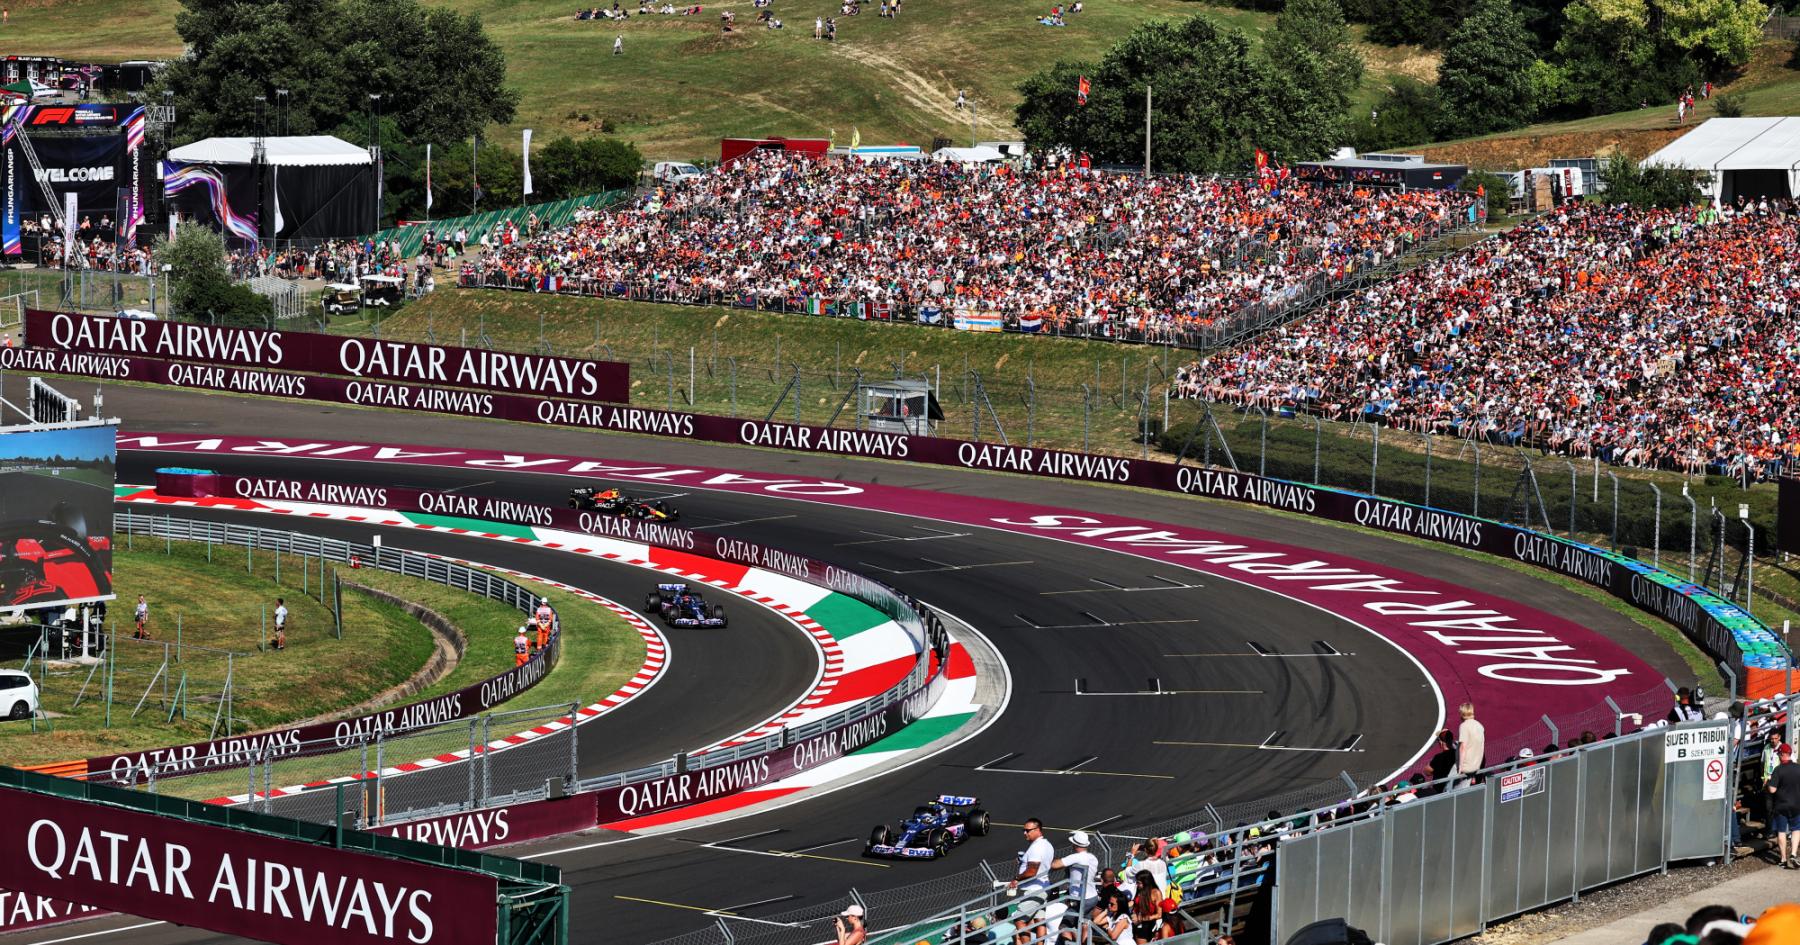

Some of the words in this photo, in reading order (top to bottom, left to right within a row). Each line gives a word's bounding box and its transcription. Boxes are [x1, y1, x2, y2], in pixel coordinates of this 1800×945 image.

[34, 166, 114, 182] WELCOME
[51, 314, 148, 352] QATAR
[156, 326, 282, 364] AIRWAYS
[1, 348, 55, 372] QATAR
[59, 354, 130, 378] AIRWAYS
[168, 364, 225, 388] QATAR
[230, 370, 306, 396] AIRWAYS
[340, 339, 447, 382] QATAR
[456, 350, 598, 396] AIRWAYS
[346, 381, 410, 406] QATAR
[414, 388, 493, 416] AIRWAYS
[538, 400, 603, 426] QATAR
[608, 406, 694, 436] AIRWAYS
[740, 421, 811, 449] QATAR
[816, 429, 908, 458] AIRWAYS
[958, 442, 1033, 472] QATAR
[1038, 451, 1130, 482] AIRWAYS
[236, 477, 302, 500] QATAR
[308, 482, 387, 506] AIRWAYS
[419, 492, 478, 518] QATAR
[484, 498, 552, 526] AIRWAYS
[1176, 468, 1240, 498] QATAR
[1243, 477, 1316, 512] AIRWAYS
[579, 512, 632, 544] QATAR
[636, 520, 694, 551] AIRWAYS
[1354, 499, 1412, 532] QATAR
[1414, 512, 1482, 547] AIRWAYS
[716, 536, 758, 565] QATAR
[762, 547, 809, 578] AIRWAYS
[989, 514, 1442, 596] AIRWAYS
[1514, 532, 1558, 566] QATAR
[1560, 545, 1613, 589] AIRWAYS
[826, 565, 858, 592] QATAR
[1631, 574, 1664, 614] QATAR
[1664, 592, 1698, 633] AIRWAYS
[1363, 599, 1633, 686] QATAR
[1706, 616, 1729, 654] QATAR
[480, 672, 514, 708] QATAR
[515, 656, 546, 692] AIRWAYS
[336, 711, 394, 748] QATAR
[400, 694, 462, 729] AIRWAYS
[793, 732, 837, 770] QATAR
[839, 710, 886, 758] AIRWAYS
[1666, 732, 1689, 747] SILVER
[1692, 734, 1696, 744] 1
[112, 745, 196, 785] QATAR
[204, 729, 300, 768] AIRWAYS
[1678, 749, 1686, 758] B
[618, 774, 691, 816] QATAR
[696, 755, 770, 800] AIRWAYS
[27, 818, 194, 899] QATAR
[208, 852, 435, 944] AIRWAYS
